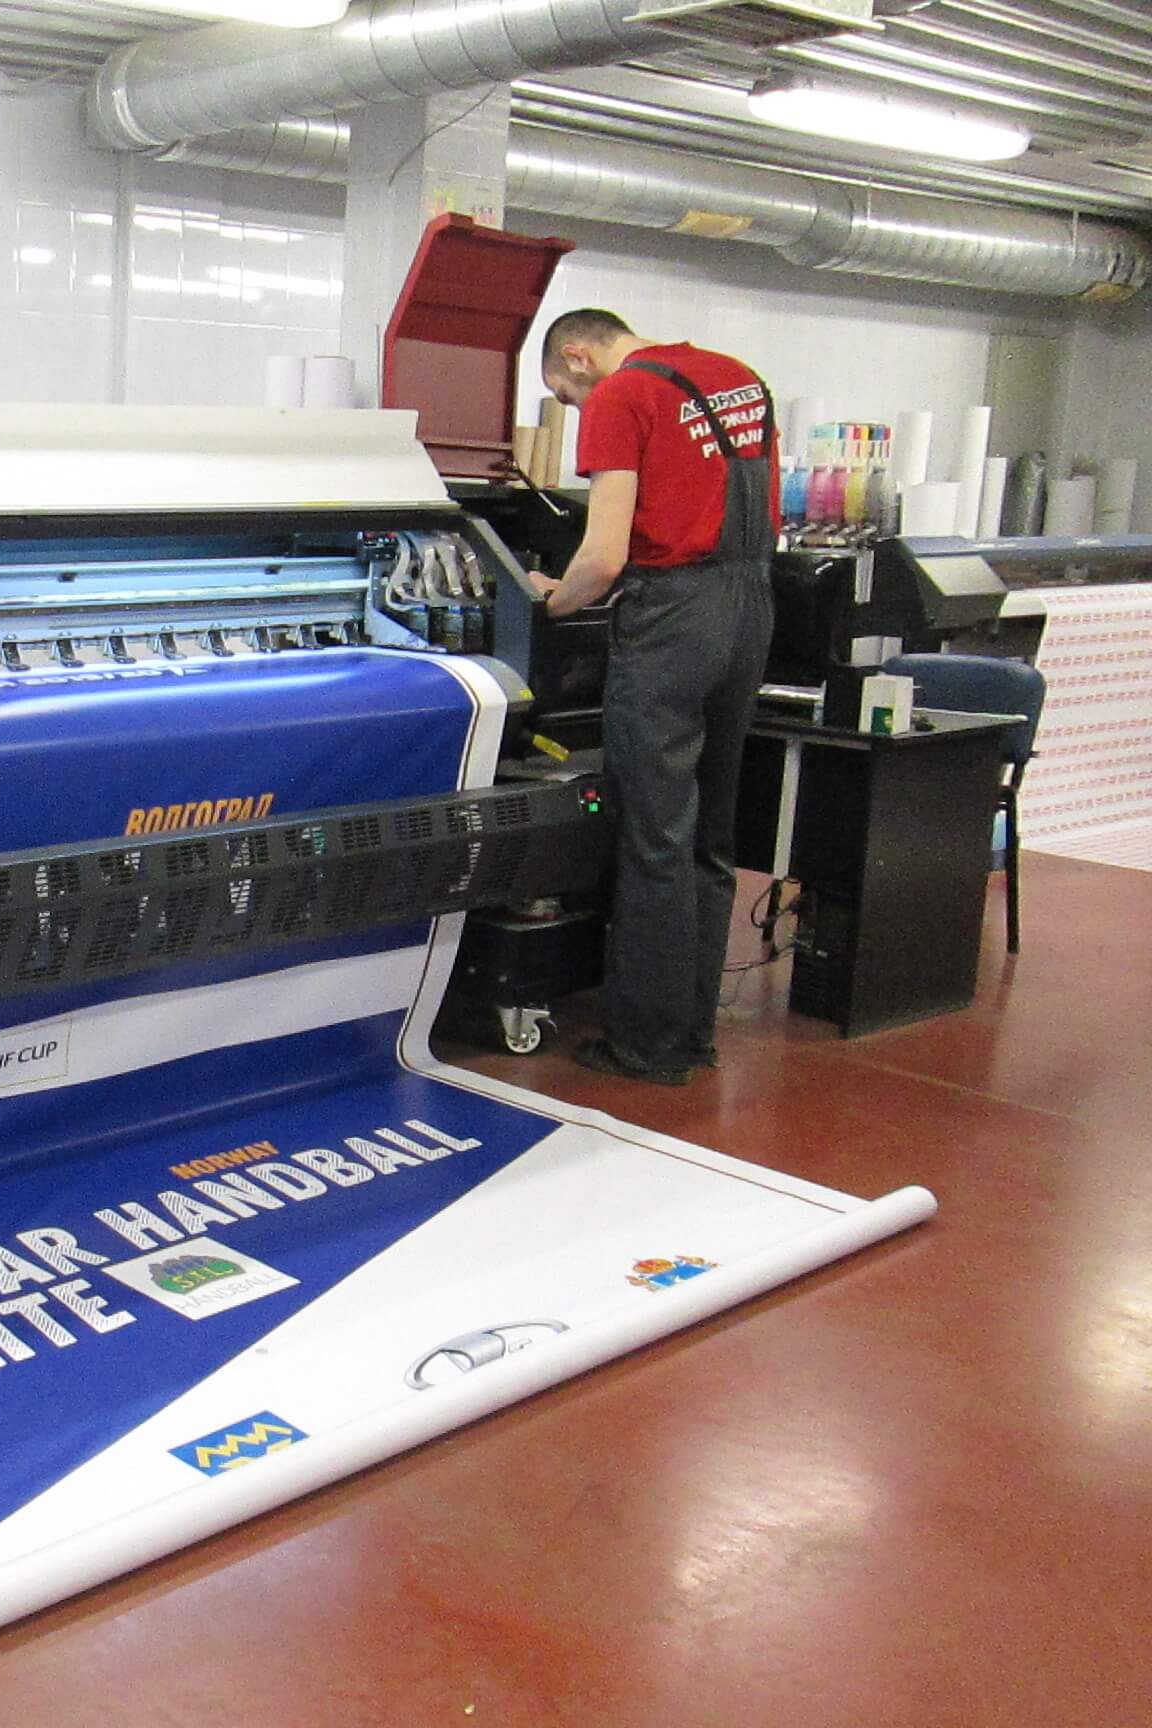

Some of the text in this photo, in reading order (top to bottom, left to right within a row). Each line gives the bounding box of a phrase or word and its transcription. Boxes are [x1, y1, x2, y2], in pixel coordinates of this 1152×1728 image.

[18, 1041, 58, 1062] CUP
[168, 1140, 279, 1180] NORWAY
[93, 1119, 483, 1251] HANDBALL
